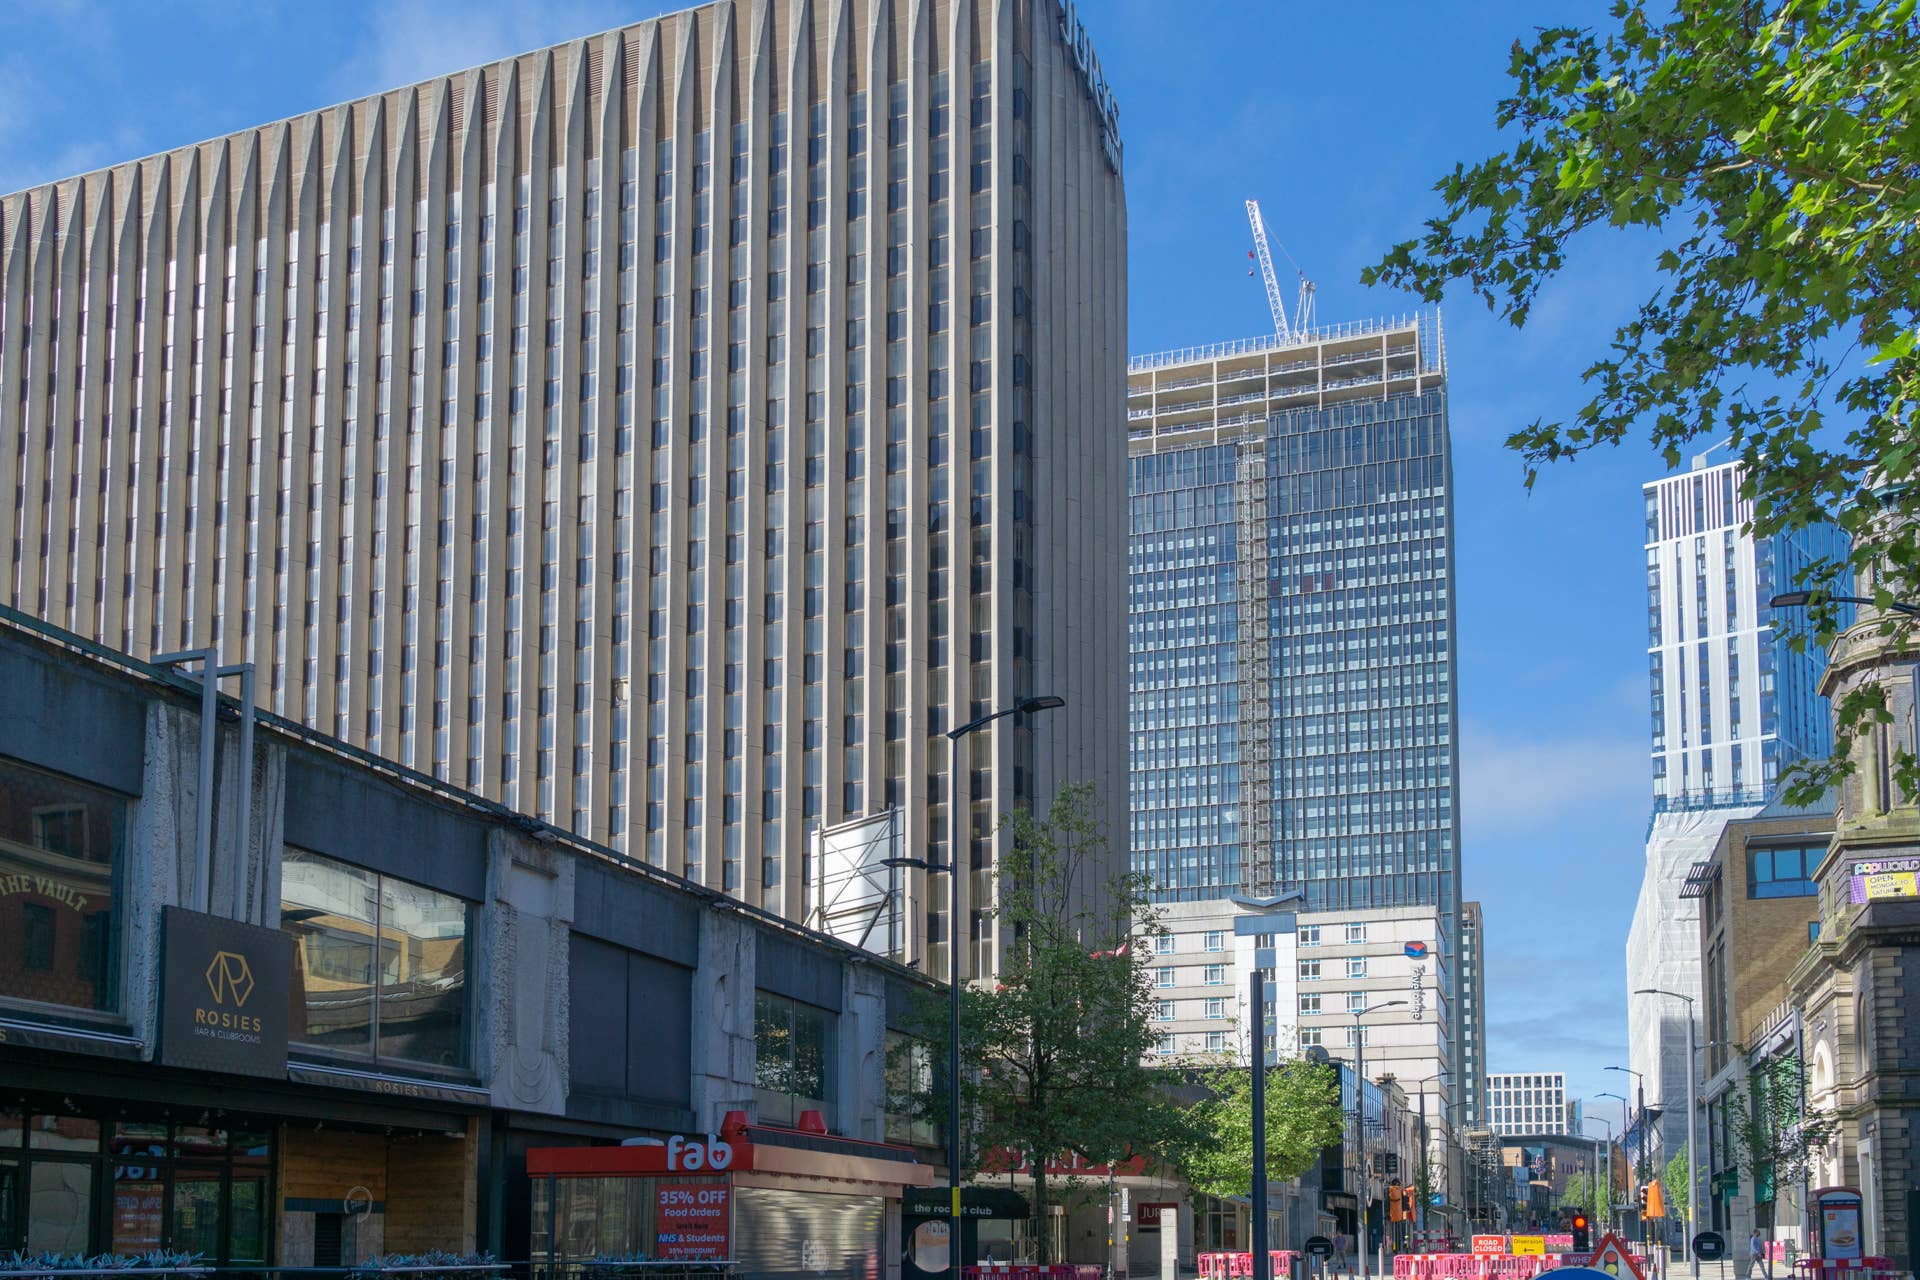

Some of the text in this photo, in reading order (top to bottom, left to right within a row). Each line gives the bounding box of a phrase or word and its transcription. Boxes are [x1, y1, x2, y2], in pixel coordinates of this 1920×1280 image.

[1870, 875, 1894, 883] OPEN
[0, 875, 88, 912] THE VAULT
[195, 1007, 261, 1032] ROSIES
[376, 1081, 418, 1096] ROSIES
[667, 1134, 732, 1171] fab
[660, 1190, 726, 1205] 35% OFF
[665, 1207, 721, 1217] Food Orders
[915, 1204, 931, 1213] the
[970, 1206, 993, 1215] club
[658, 1232, 725, 1243] NHS & Students
[684, 1247, 716, 1255] DISCOUNT
